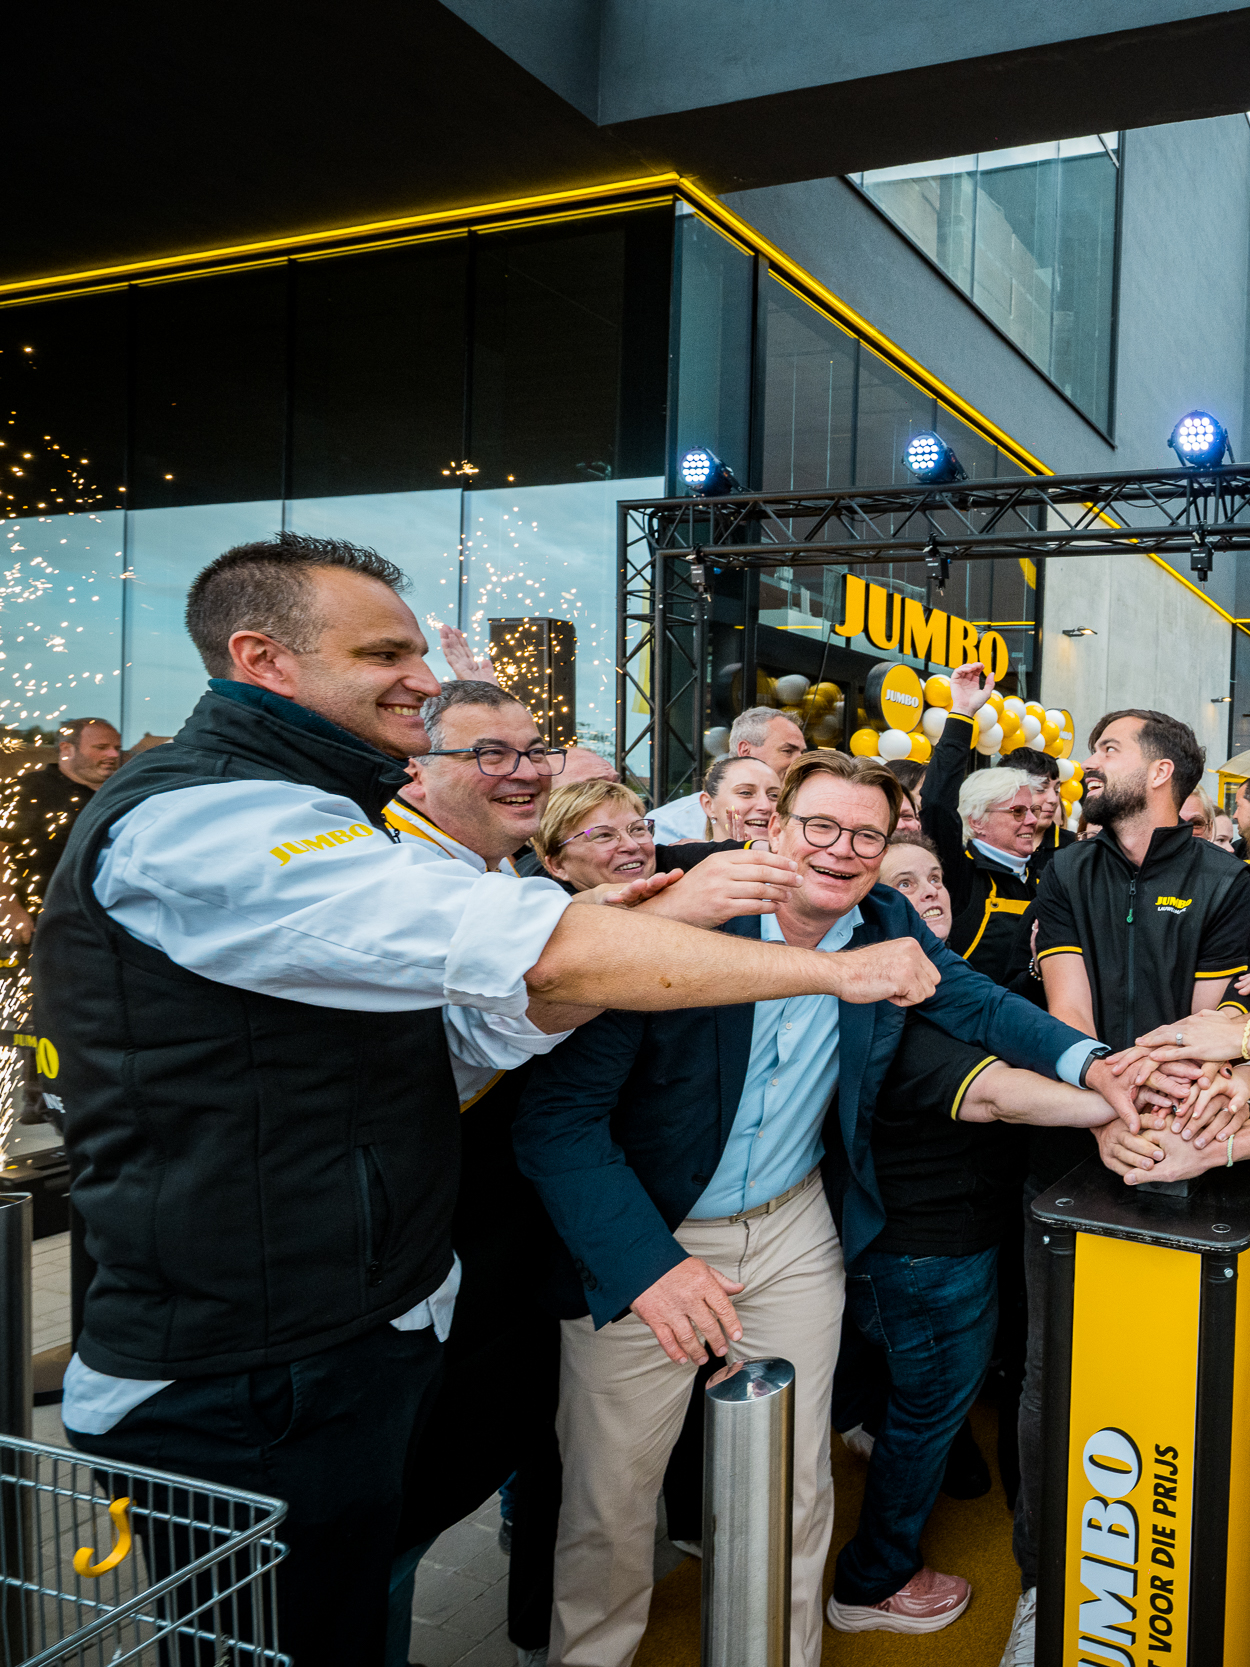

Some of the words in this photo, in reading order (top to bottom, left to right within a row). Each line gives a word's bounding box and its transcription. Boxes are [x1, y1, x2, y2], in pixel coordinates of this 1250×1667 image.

[834, 573, 1009, 682] JUMBO
[885, 689, 919, 708] JUMBO
[269, 823, 374, 867] JUMBO
[1155, 896, 1193, 909] JUMBO
[13, 1034, 38, 1048] JUM
[1152, 1443, 1179, 1519] PRIJS
[1077, 1426, 1143, 1667] UMBO
[1150, 1523, 1177, 1570] DIE
[1147, 1574, 1174, 1653] VOOR
